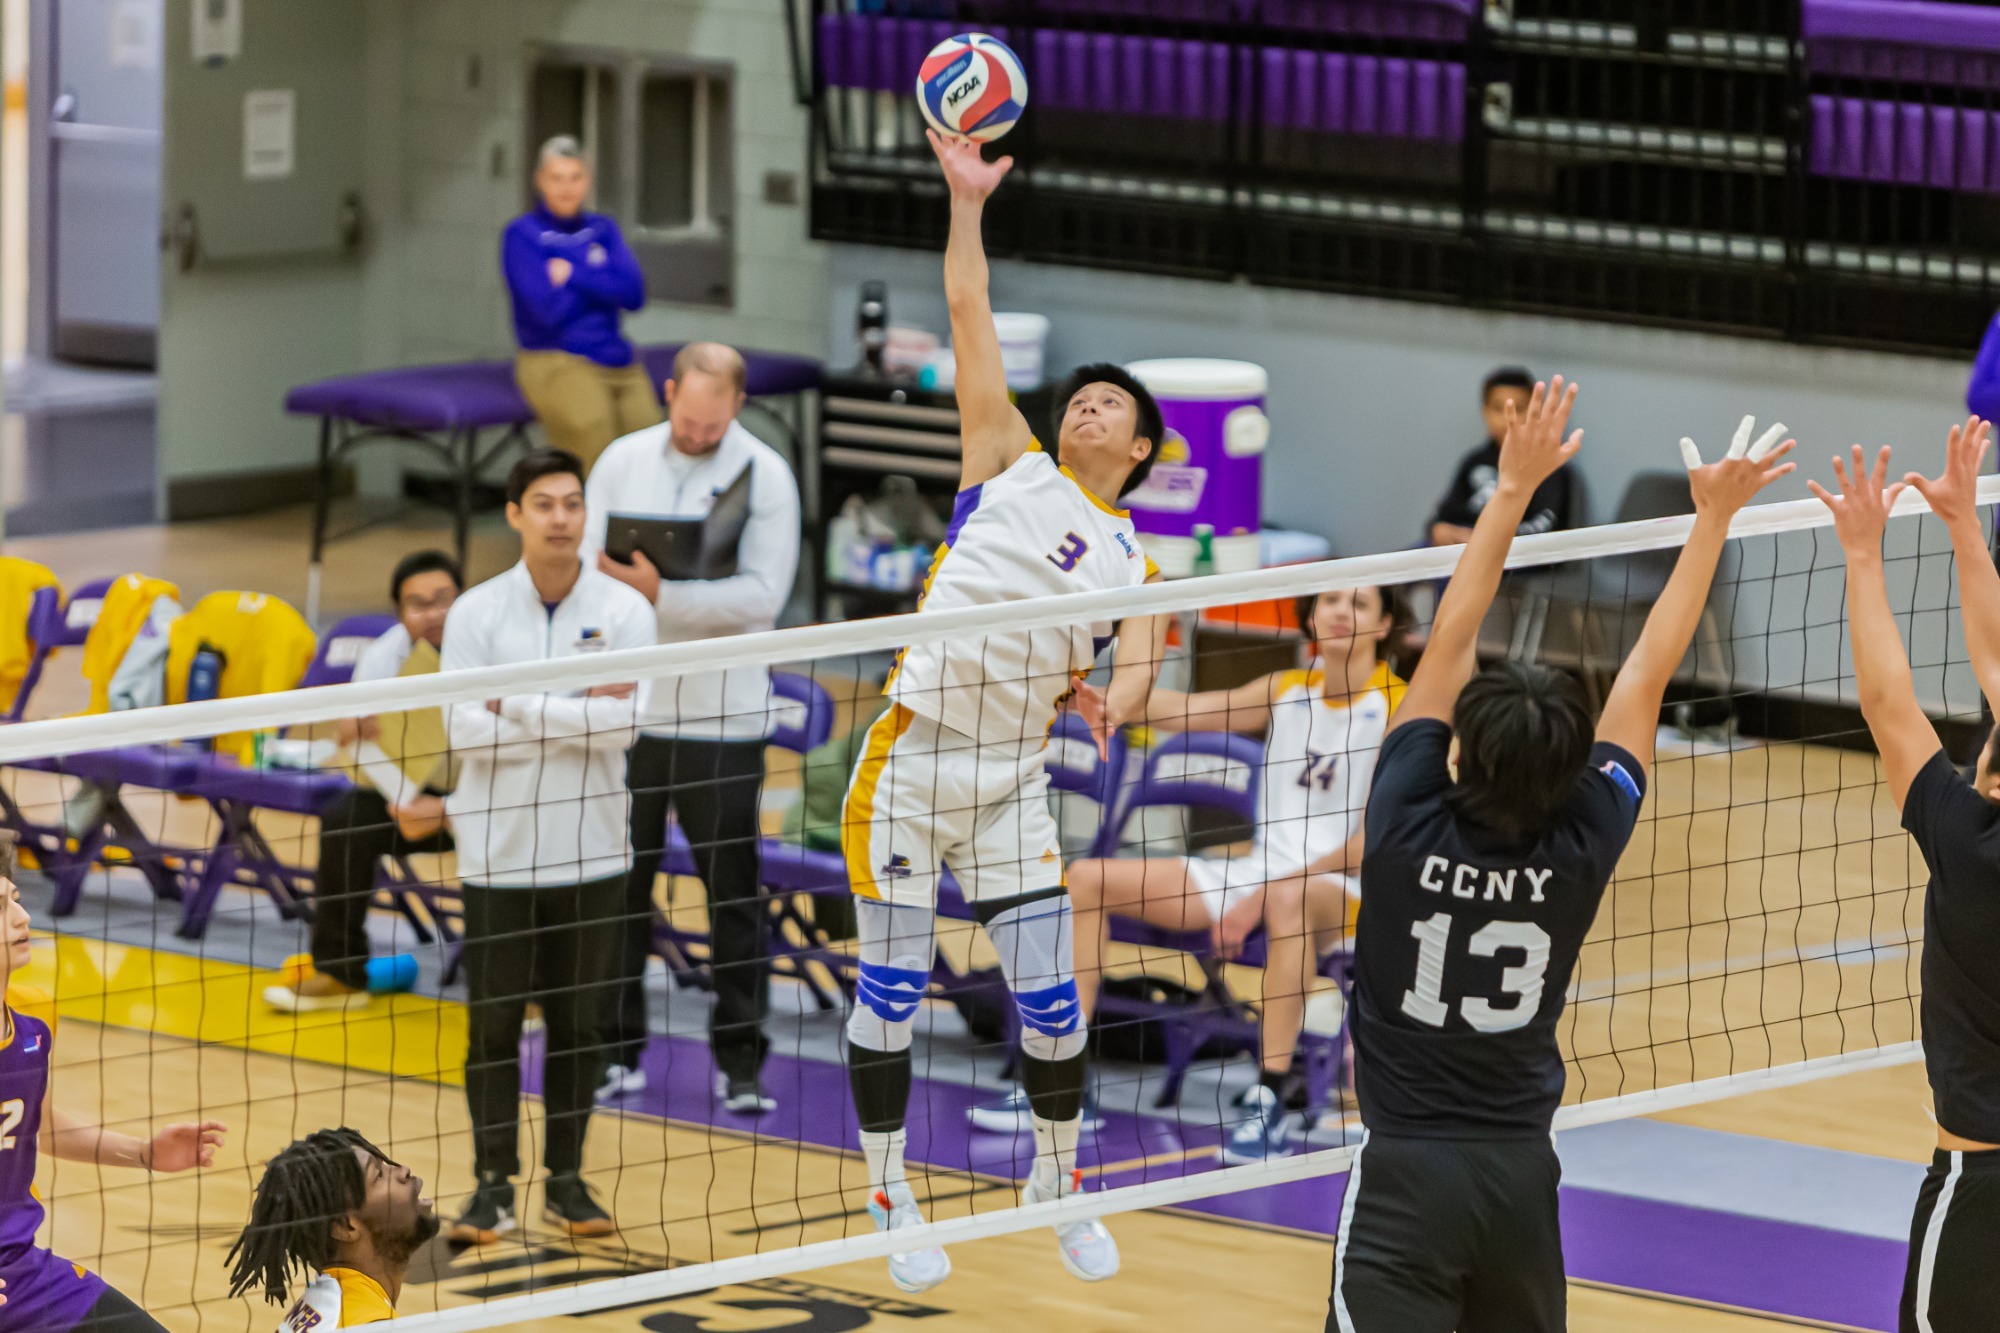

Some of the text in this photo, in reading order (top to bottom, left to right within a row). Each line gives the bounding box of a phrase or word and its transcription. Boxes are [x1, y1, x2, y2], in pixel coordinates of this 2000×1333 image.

[946, 75, 981, 108] NCAA
[1046, 531, 1088, 572] 3
[1297, 750, 1337, 791] 24
[1419, 855, 1553, 902] CCNY
[1401, 912, 1552, 1033] 13
